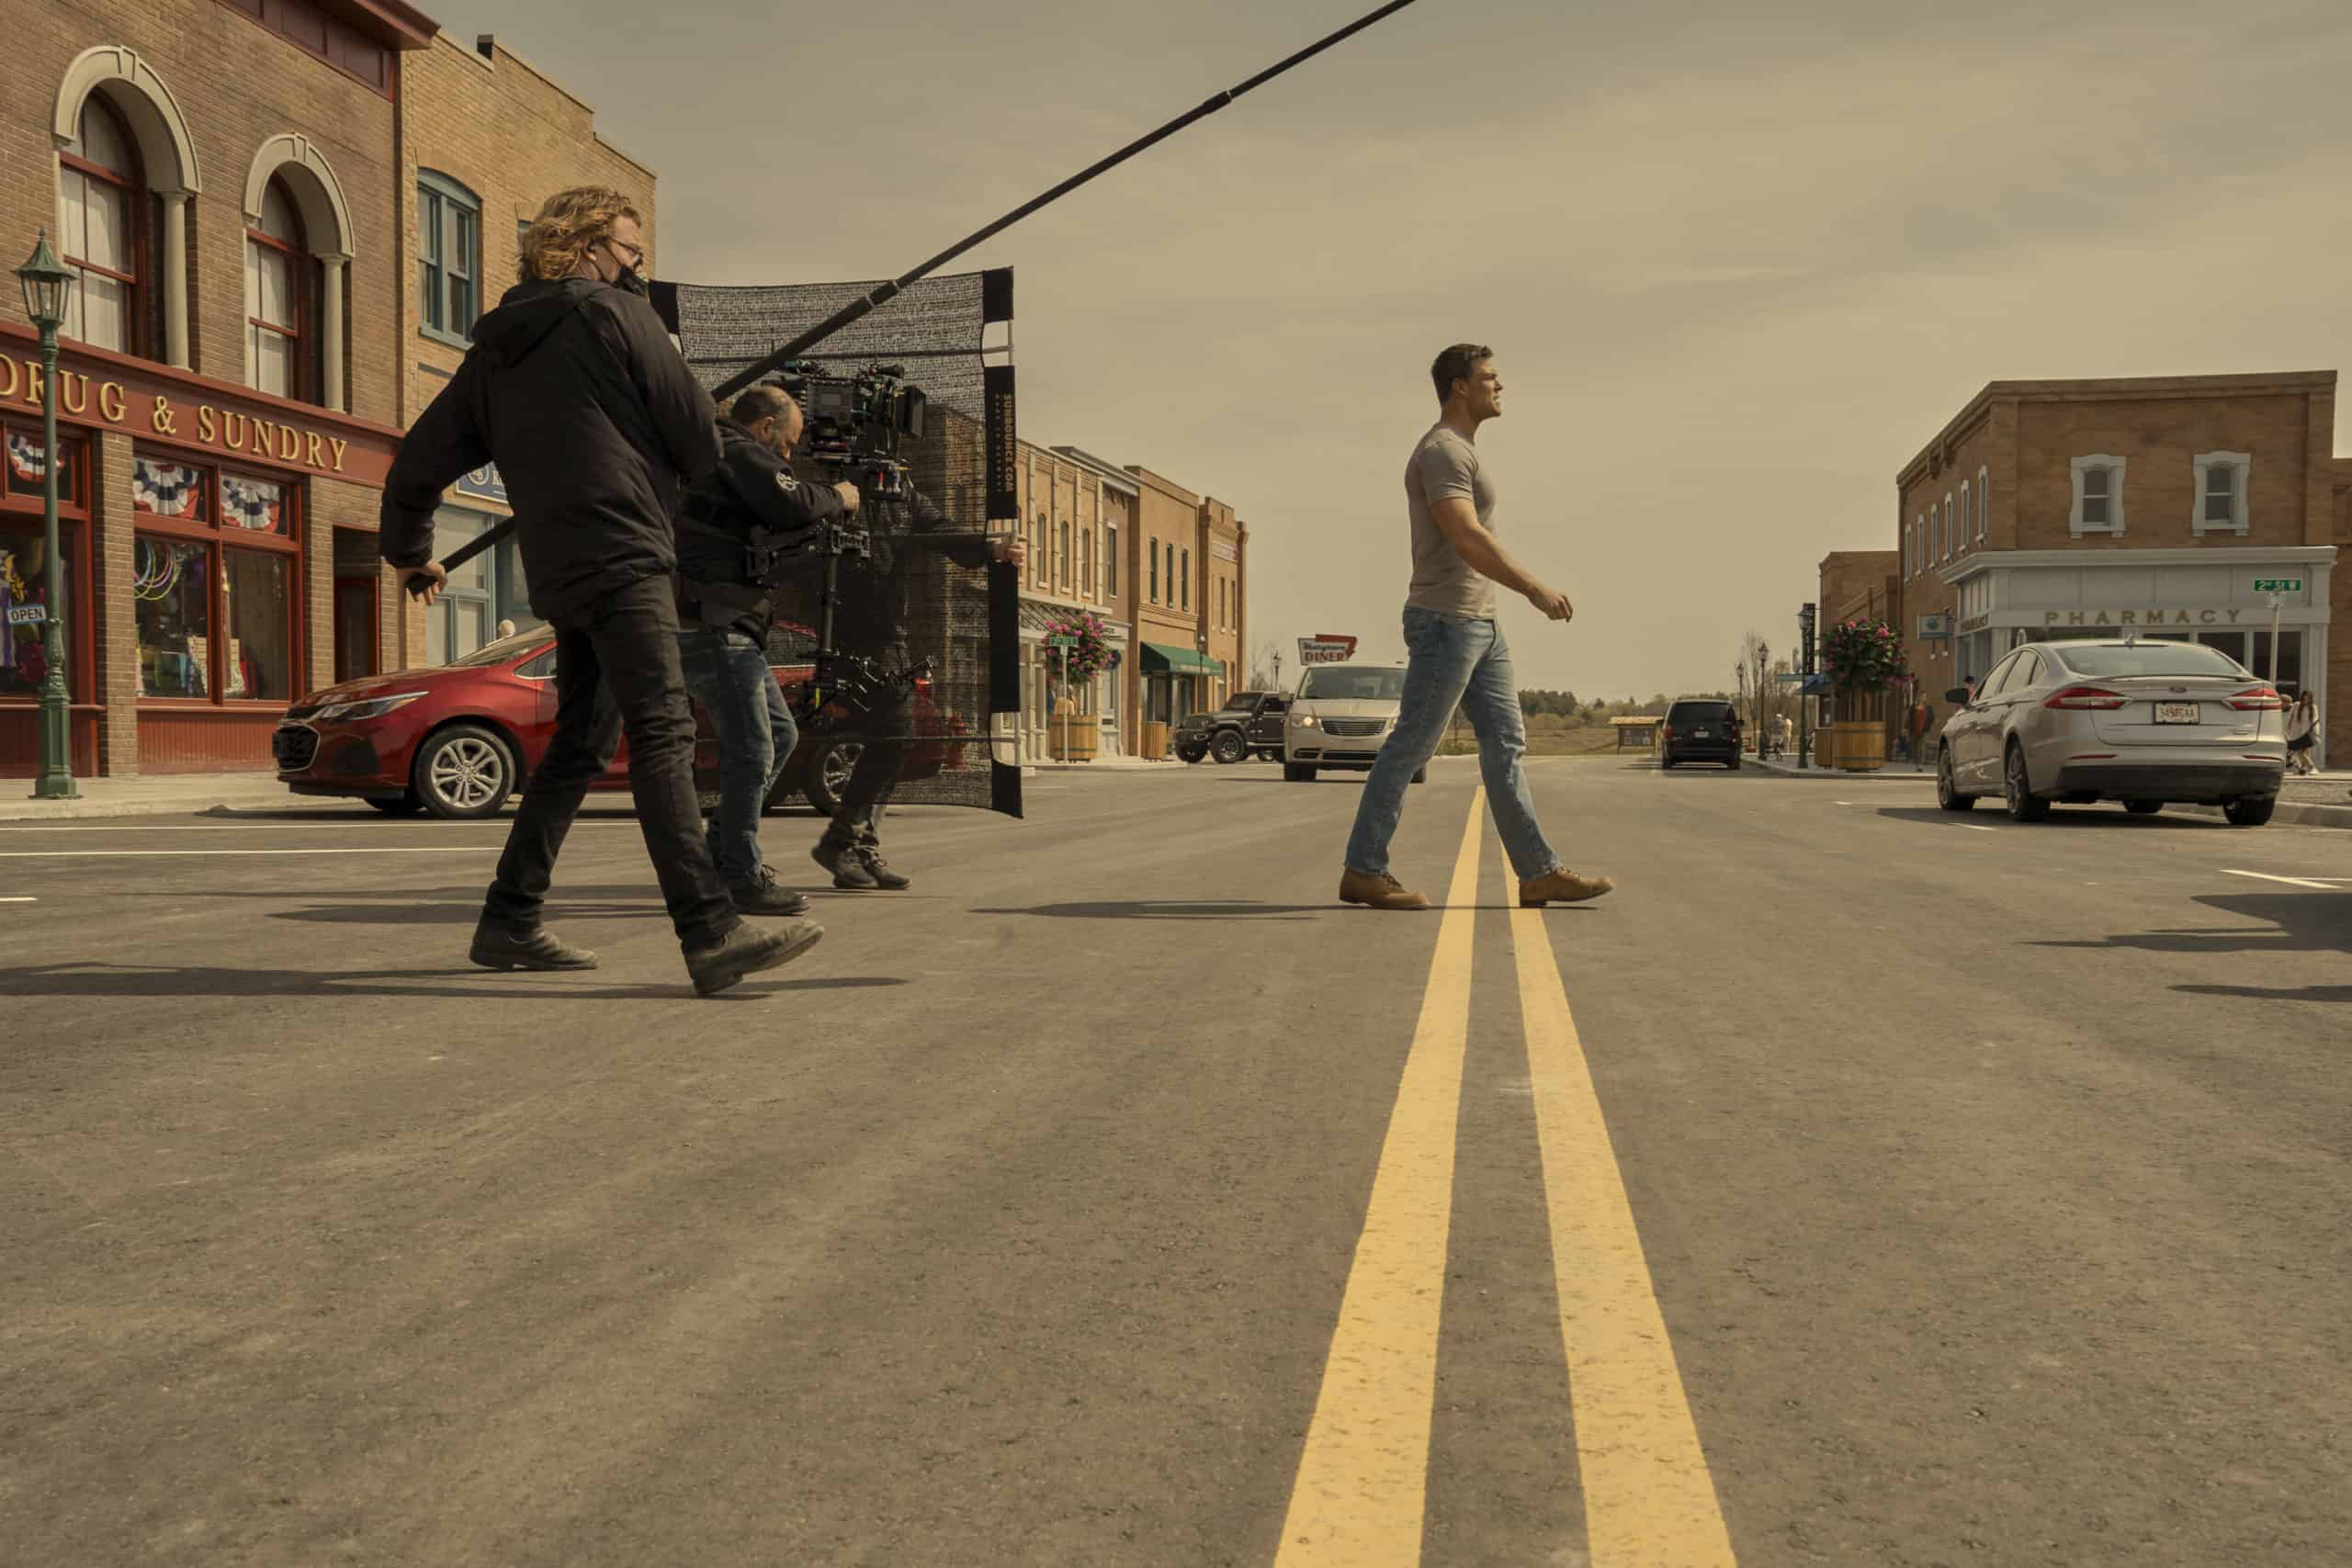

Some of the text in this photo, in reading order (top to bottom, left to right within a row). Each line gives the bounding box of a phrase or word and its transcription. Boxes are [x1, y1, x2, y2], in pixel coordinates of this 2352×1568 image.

[0, 354, 347, 471] DRUG & SUNDRY
[11, 607, 44, 622] OPEN
[2044, 610, 2241, 626] PHARMACY
[1305, 651, 1345, 662] DINER
